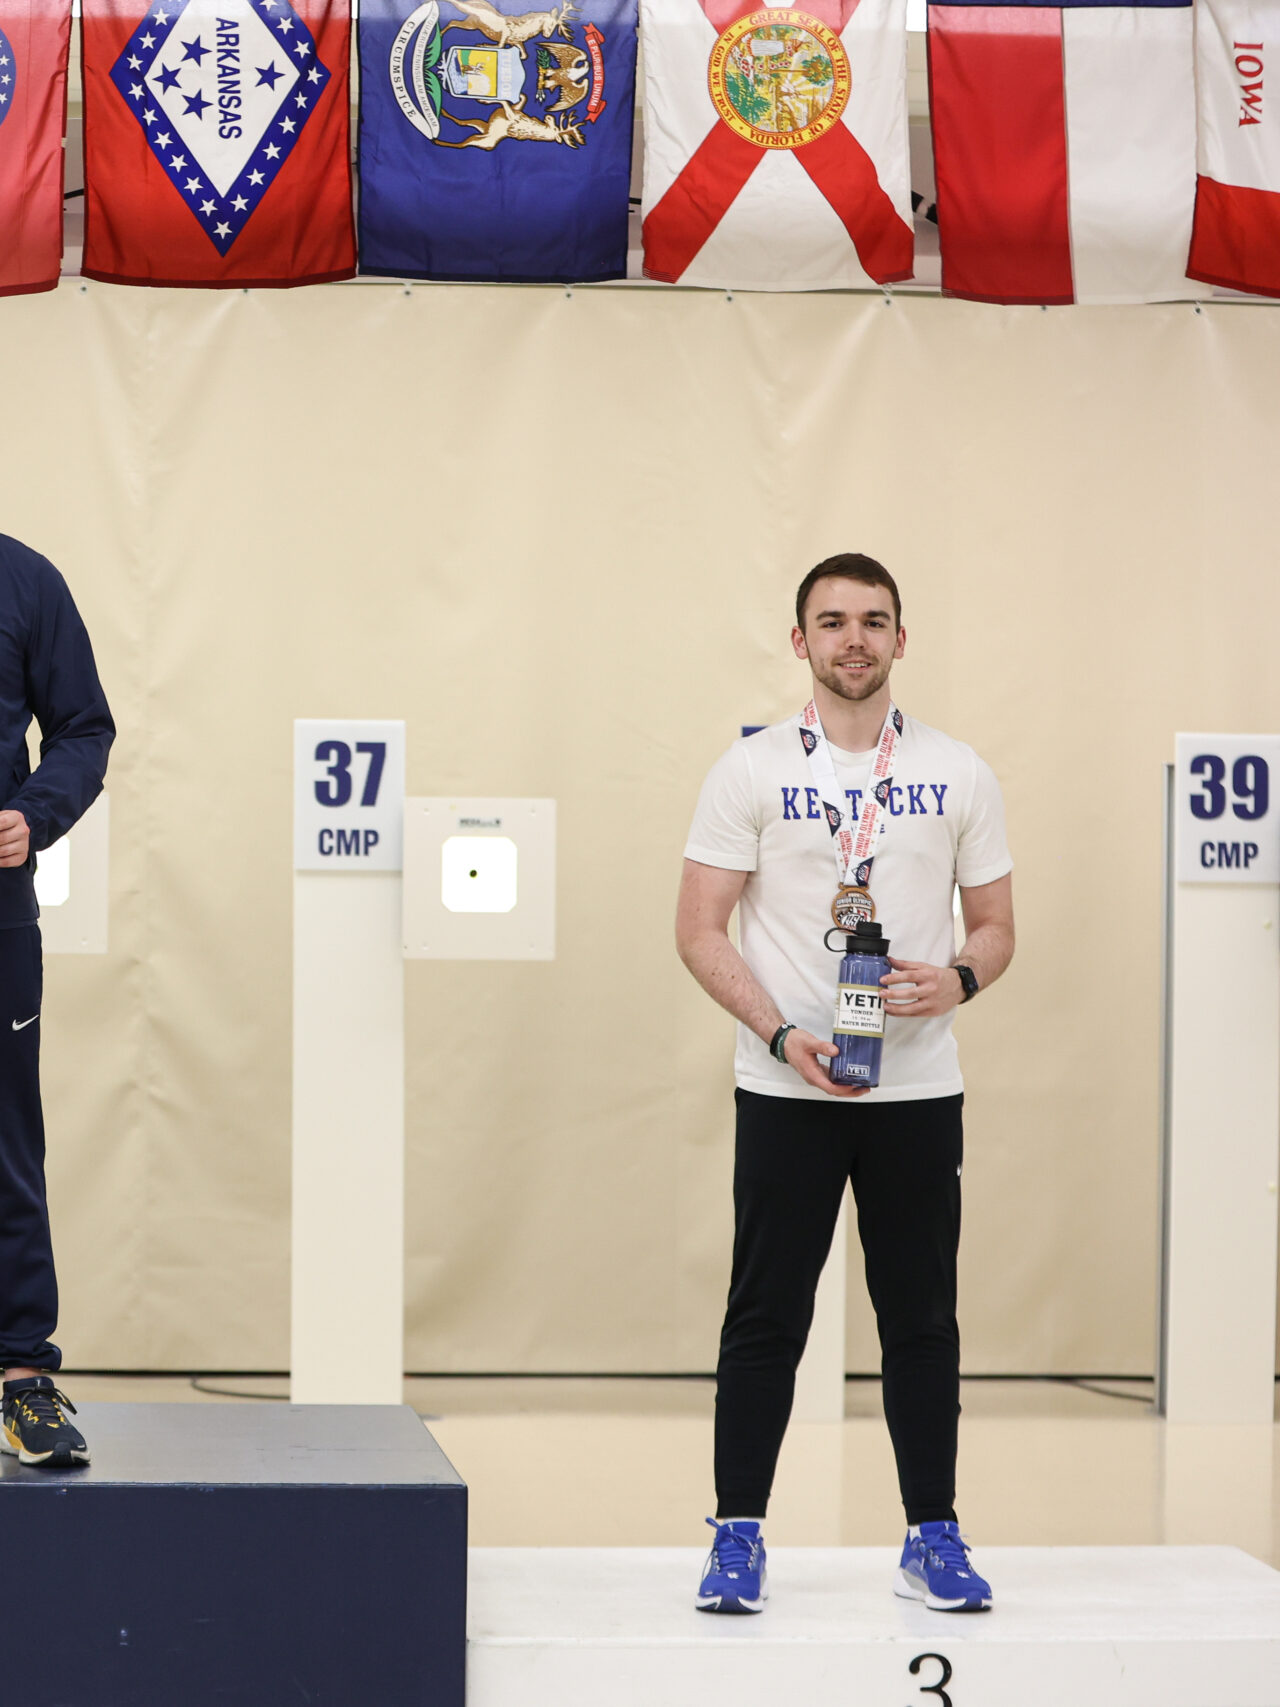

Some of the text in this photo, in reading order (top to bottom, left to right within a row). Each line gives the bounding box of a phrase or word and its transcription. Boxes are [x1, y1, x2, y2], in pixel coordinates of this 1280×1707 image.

[215, 17, 242, 140] ARKANSAS
[392, 21, 416, 118] CIRCUMSPICE
[712, 31, 736, 122] IN GOD WE TRUST
[749, 10, 847, 147] GREAT SEAL OF THE STATE OF FLORIDA
[1232, 42, 1265, 128] IOWA
[590, 83, 602, 107] UNUM
[314, 740, 387, 807] 37
[1190, 754, 1269, 821] 39
[781, 784, 948, 820] KETCKY
[859, 803, 873, 832] OLYMPIC
[318, 828, 380, 856] CMP
[1200, 841, 1259, 869] CMP
[844, 993, 882, 1009] YETI
[861, 1021, 880, 1029] BOTTLE
[849, 1066, 868, 1075] YETI
[906, 1653, 952, 1707] 3
